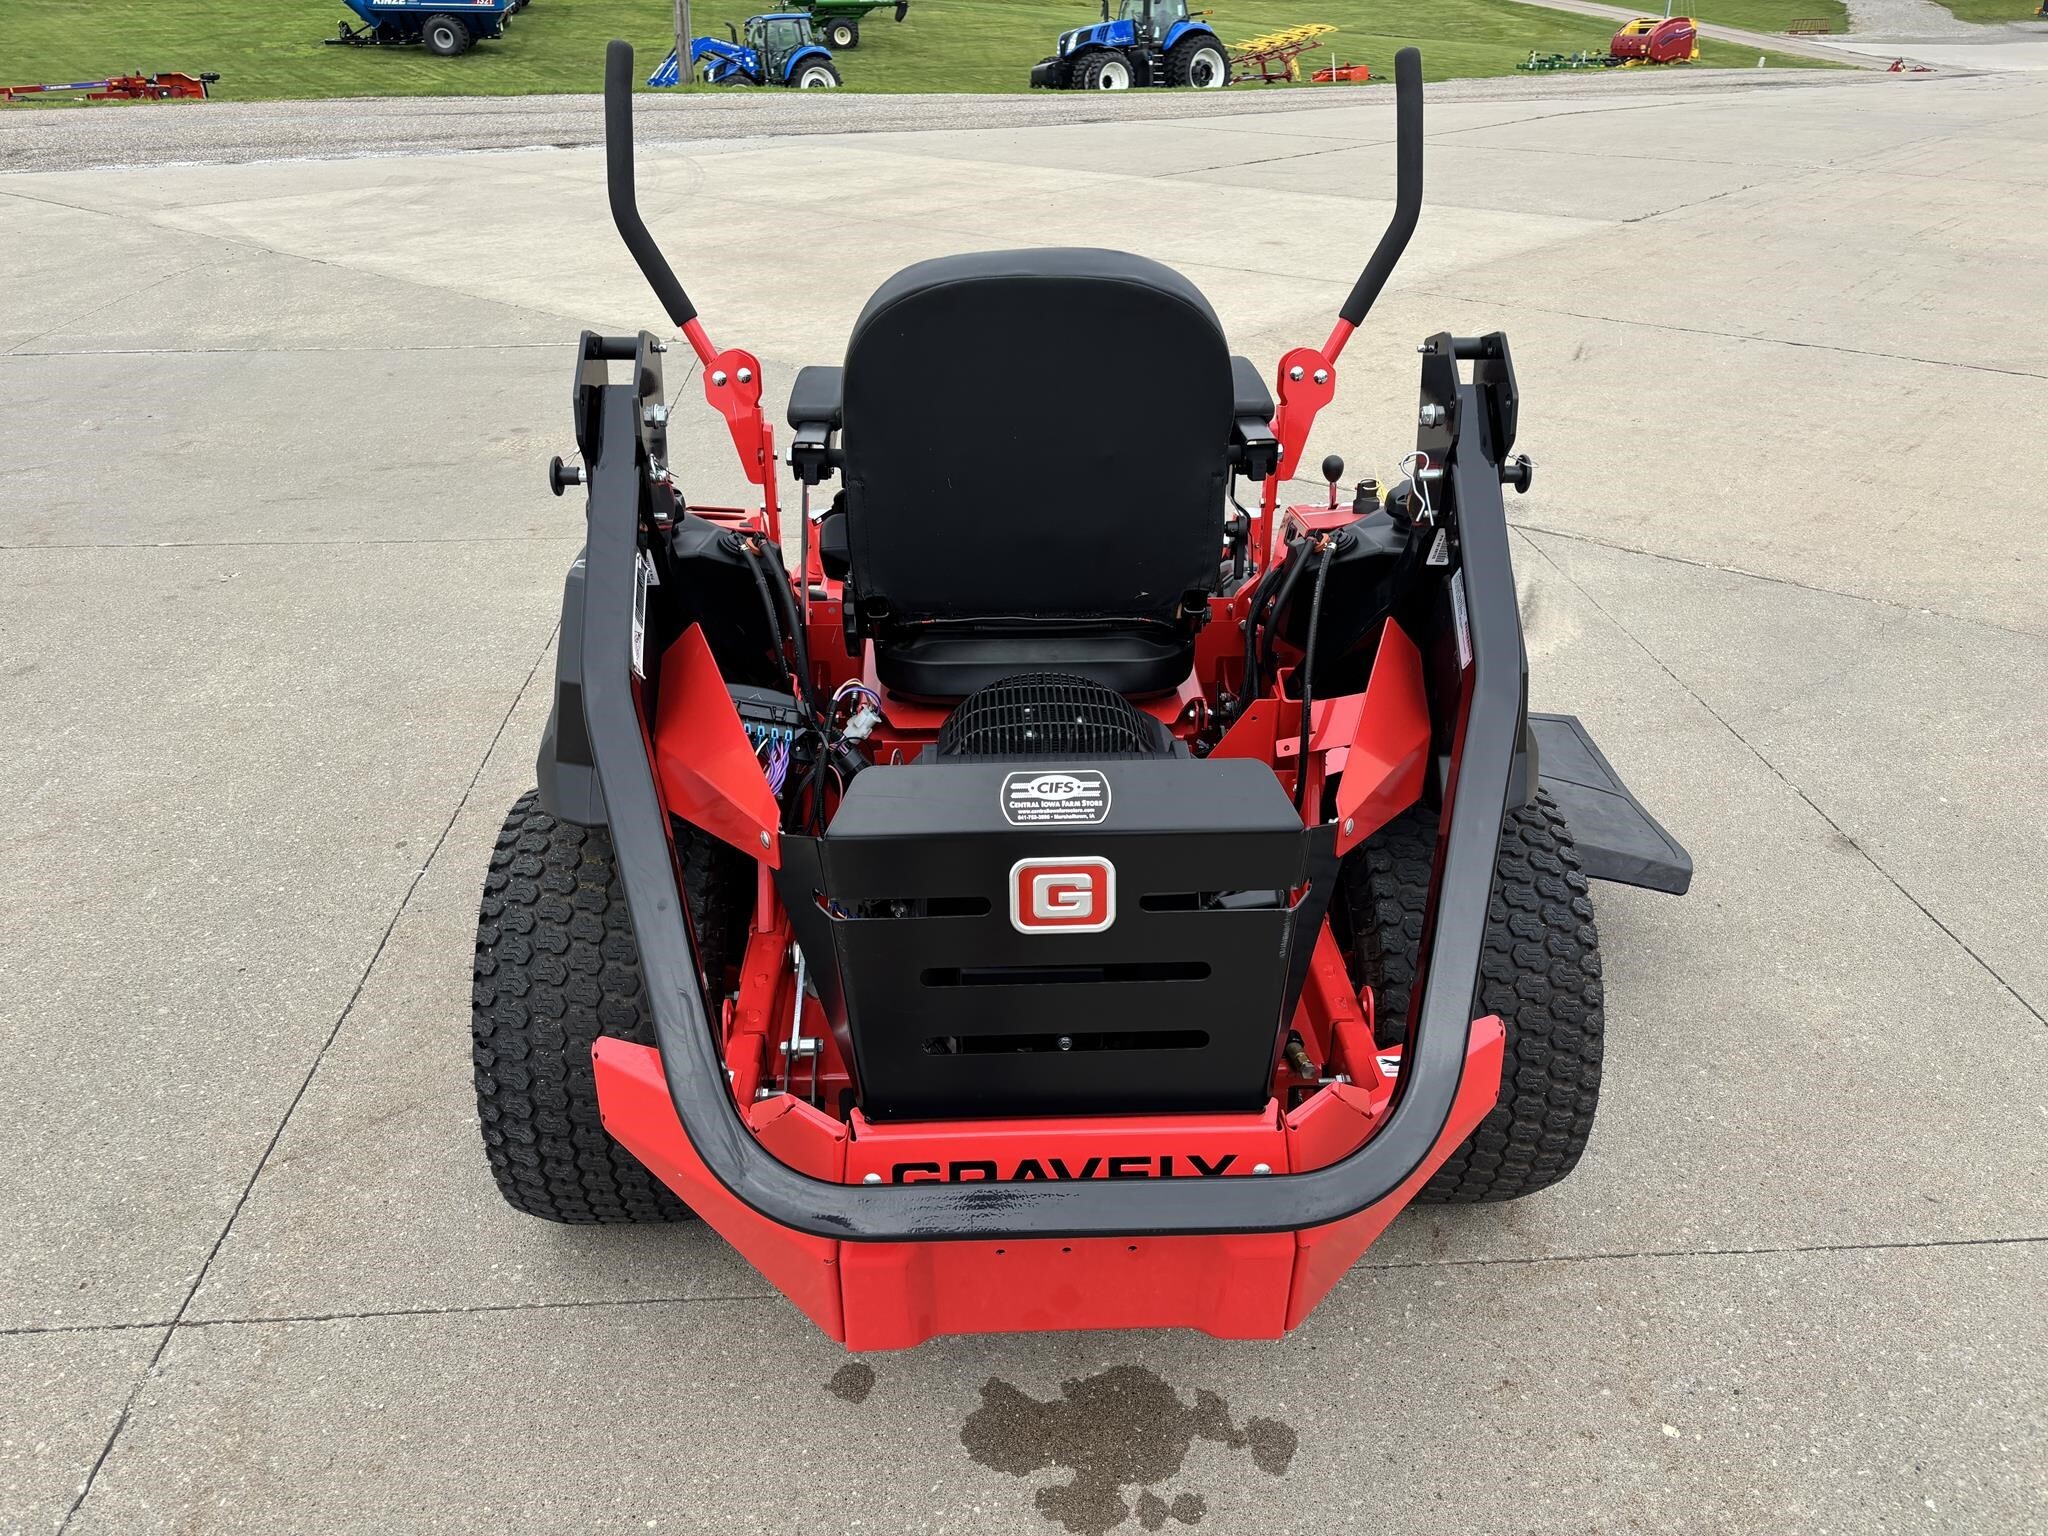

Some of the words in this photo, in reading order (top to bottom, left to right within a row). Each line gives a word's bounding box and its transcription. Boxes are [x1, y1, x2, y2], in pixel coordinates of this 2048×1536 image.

[1036, 781, 1074, 794] CIFS
[1041, 800, 1061, 808] IOWA
[1081, 799, 1103, 807] STORE
[1032, 873, 1093, 919] G
